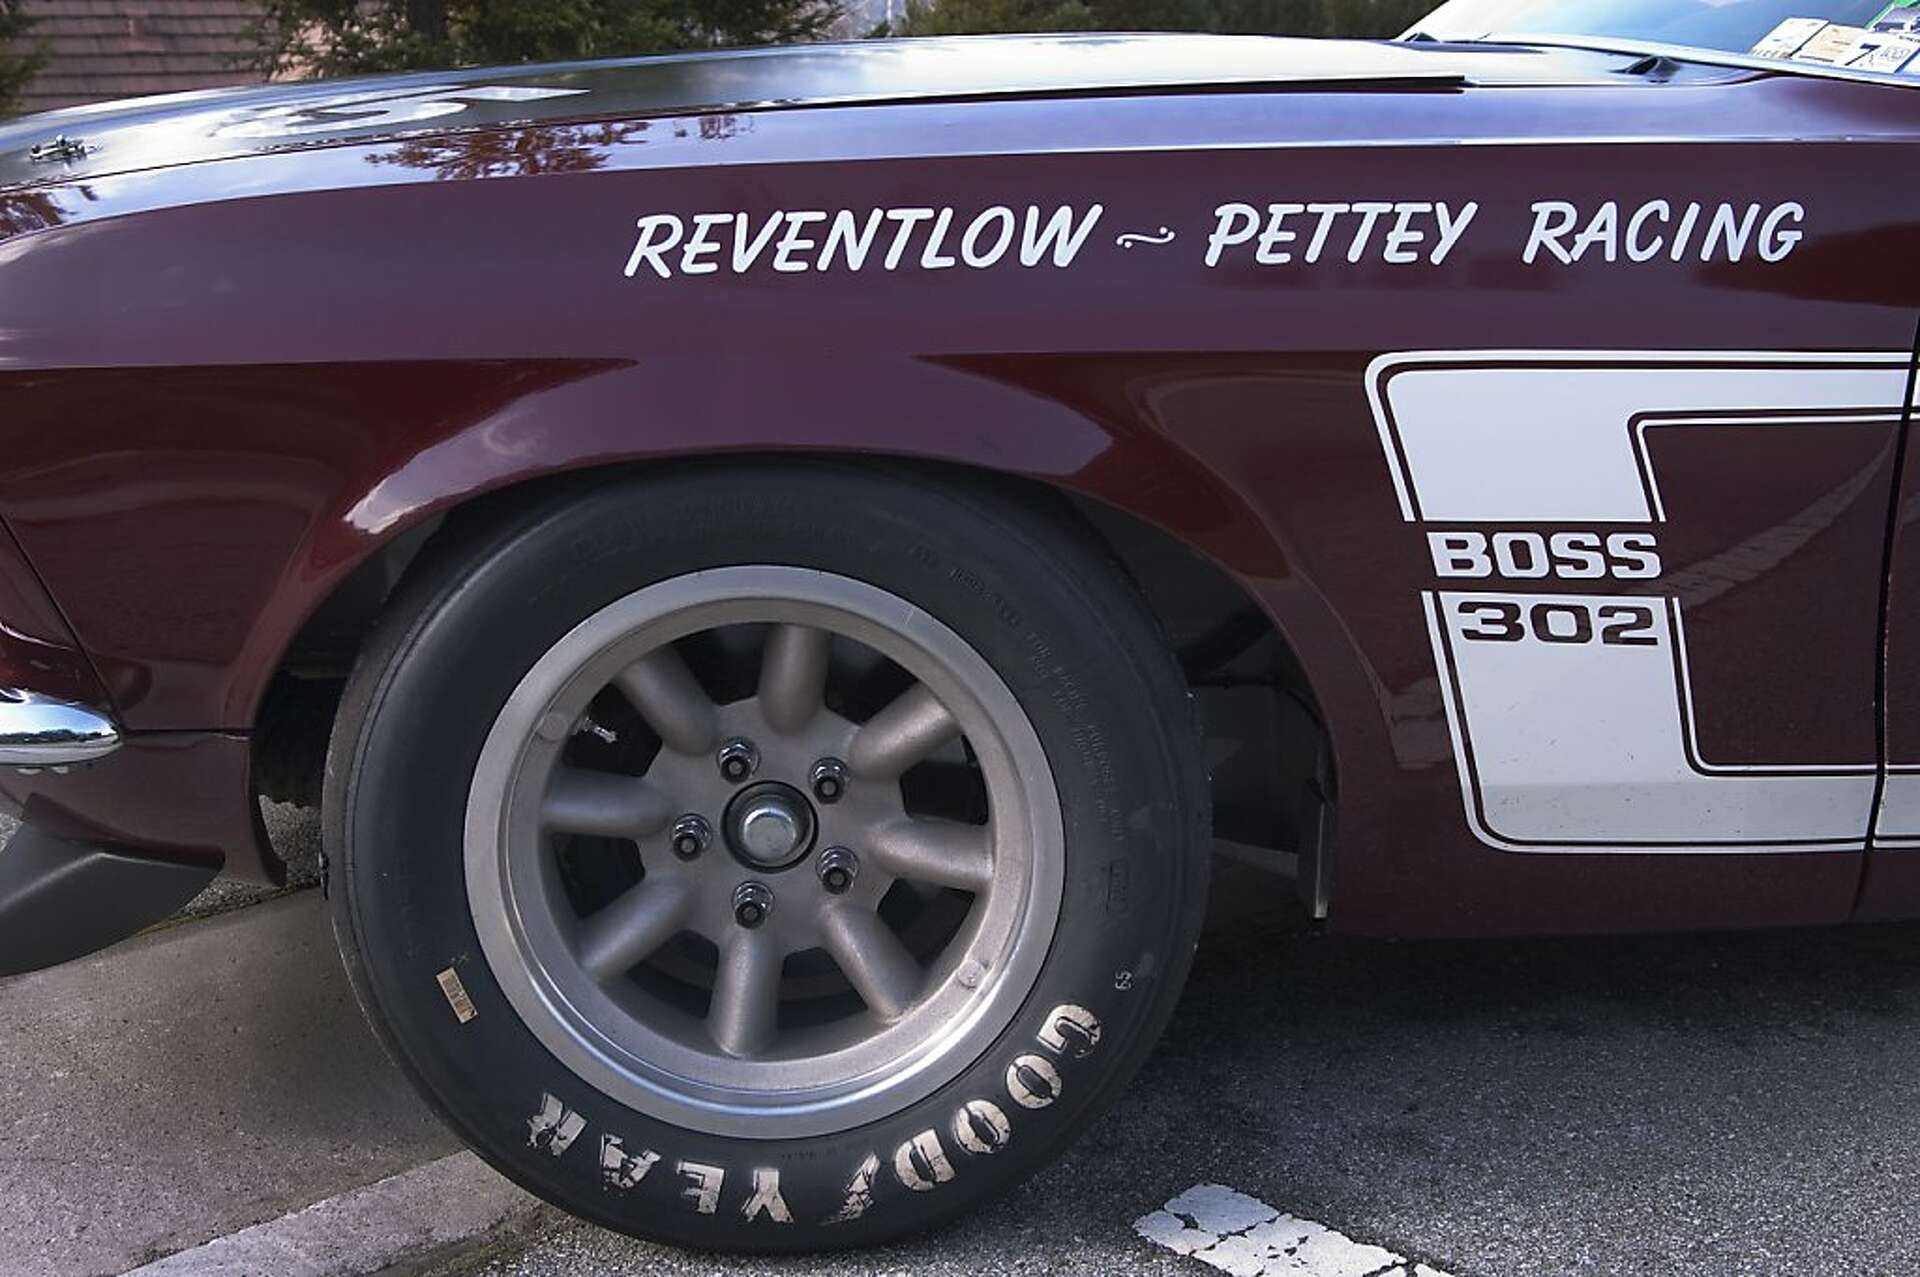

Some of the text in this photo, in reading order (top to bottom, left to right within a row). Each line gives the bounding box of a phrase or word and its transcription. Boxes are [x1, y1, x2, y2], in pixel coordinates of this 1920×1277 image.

[624, 199, 1805, 278] REVENTLOW PETTEY RACING
[1426, 531, 1662, 579] BOSS
[1457, 601, 1659, 646] 302
